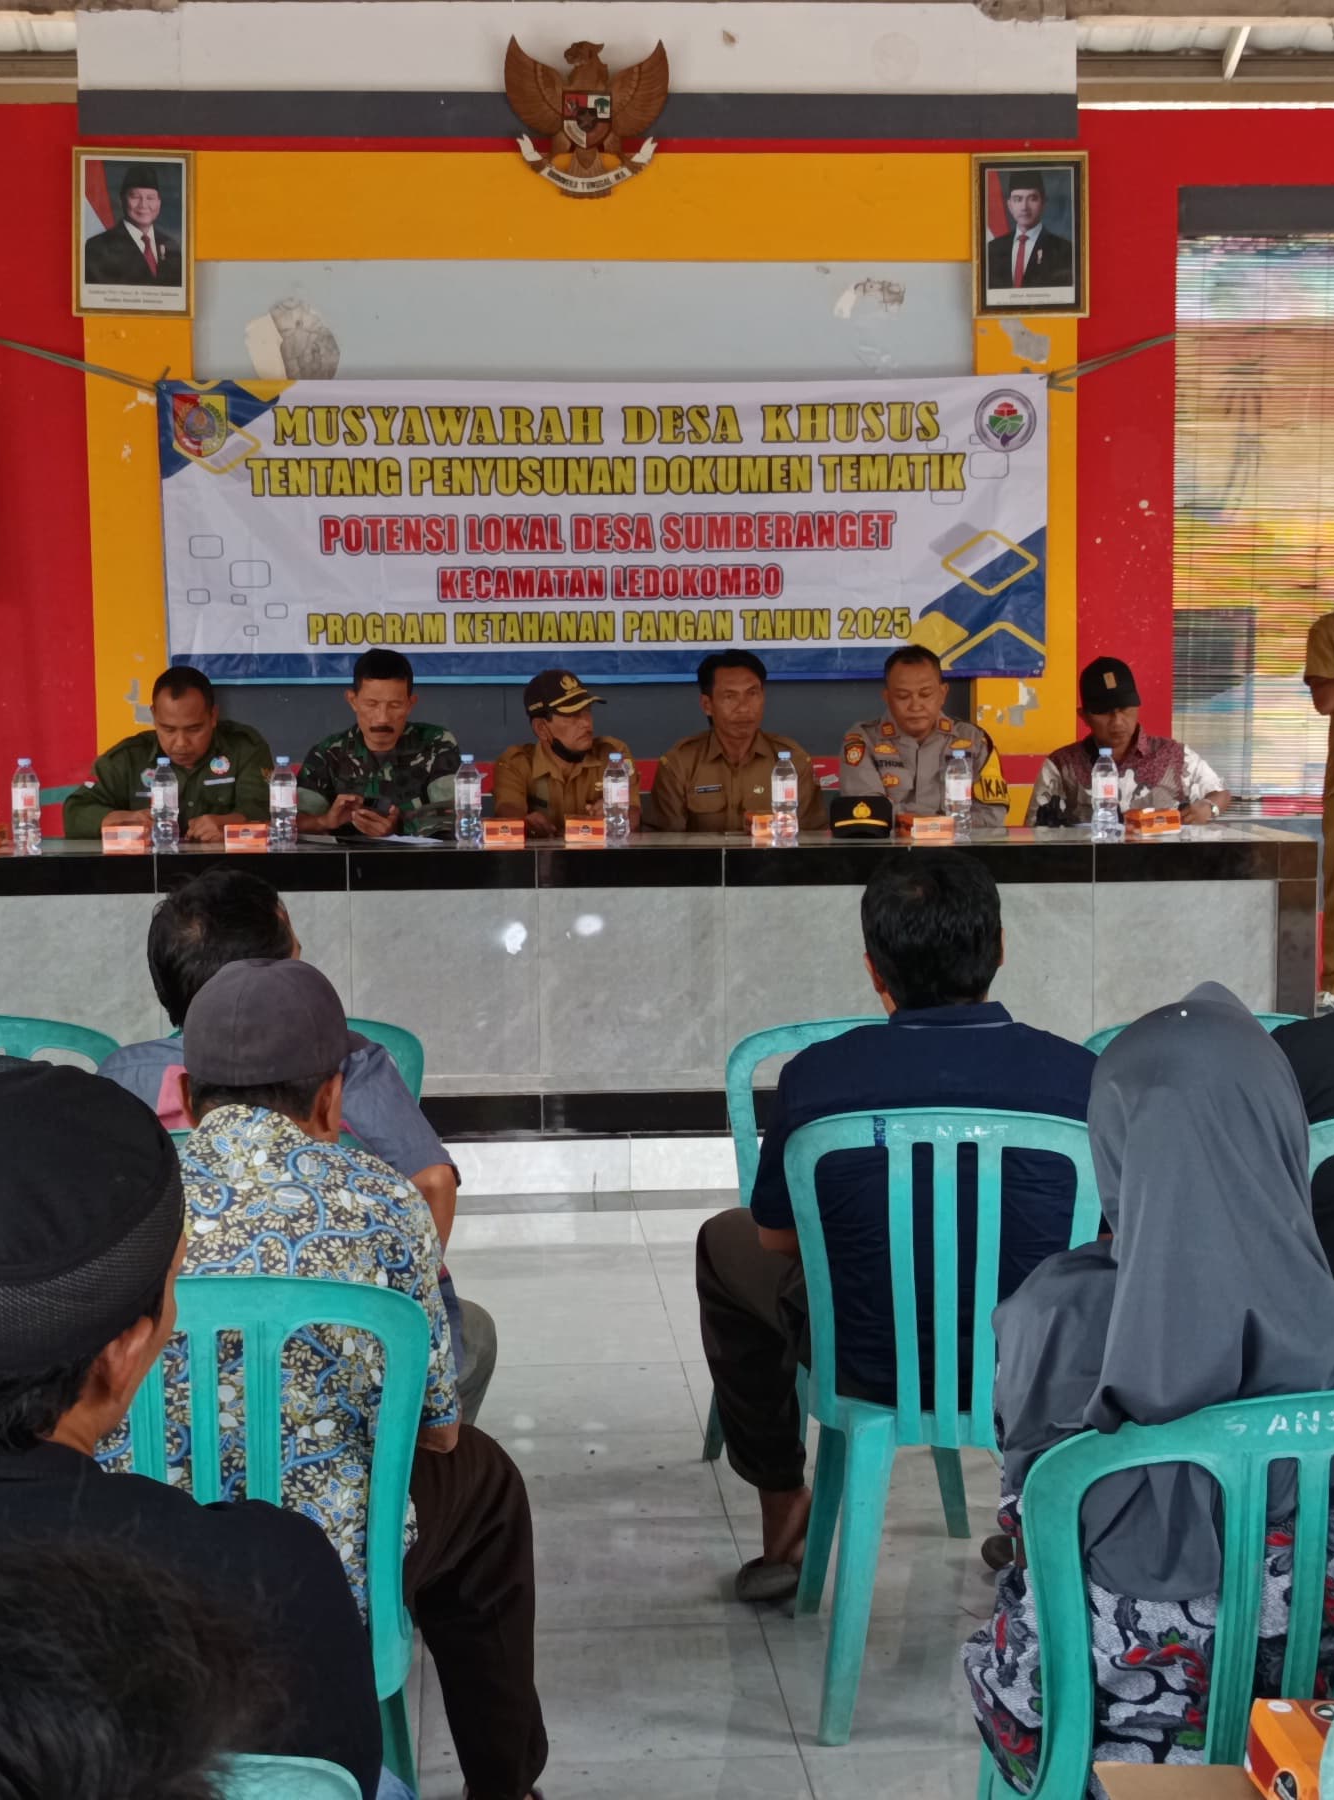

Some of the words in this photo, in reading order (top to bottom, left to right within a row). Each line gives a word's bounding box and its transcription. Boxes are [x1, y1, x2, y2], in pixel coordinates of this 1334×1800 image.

[272, 405, 604, 446] MUSYAWARAH
[622, 404, 744, 444] DESA
[762, 401, 940, 443] KHUSUS
[245, 457, 403, 497] TENTANG
[409, 456, 637, 497] PENYUSUNAN
[644, 455, 813, 495] DOKUMEN
[818, 453, 966, 493] TEMATIK
[320, 515, 459, 555] POTENSI
[465, 514, 566, 554] LOKAL
[570, 513, 656, 553] DESA
[660, 511, 896, 552] SUMBERANGET
[437, 566, 606, 601] KECAMATAN
[611, 563, 784, 599] LEDOKOMBO
[307, 612, 446, 645] PROGRAM
[454, 611, 616, 644] KETAHANAN
[623, 609, 733, 642] PANGAN
[740, 608, 831, 641] TAHUN
[838, 607, 912, 639] 2025
